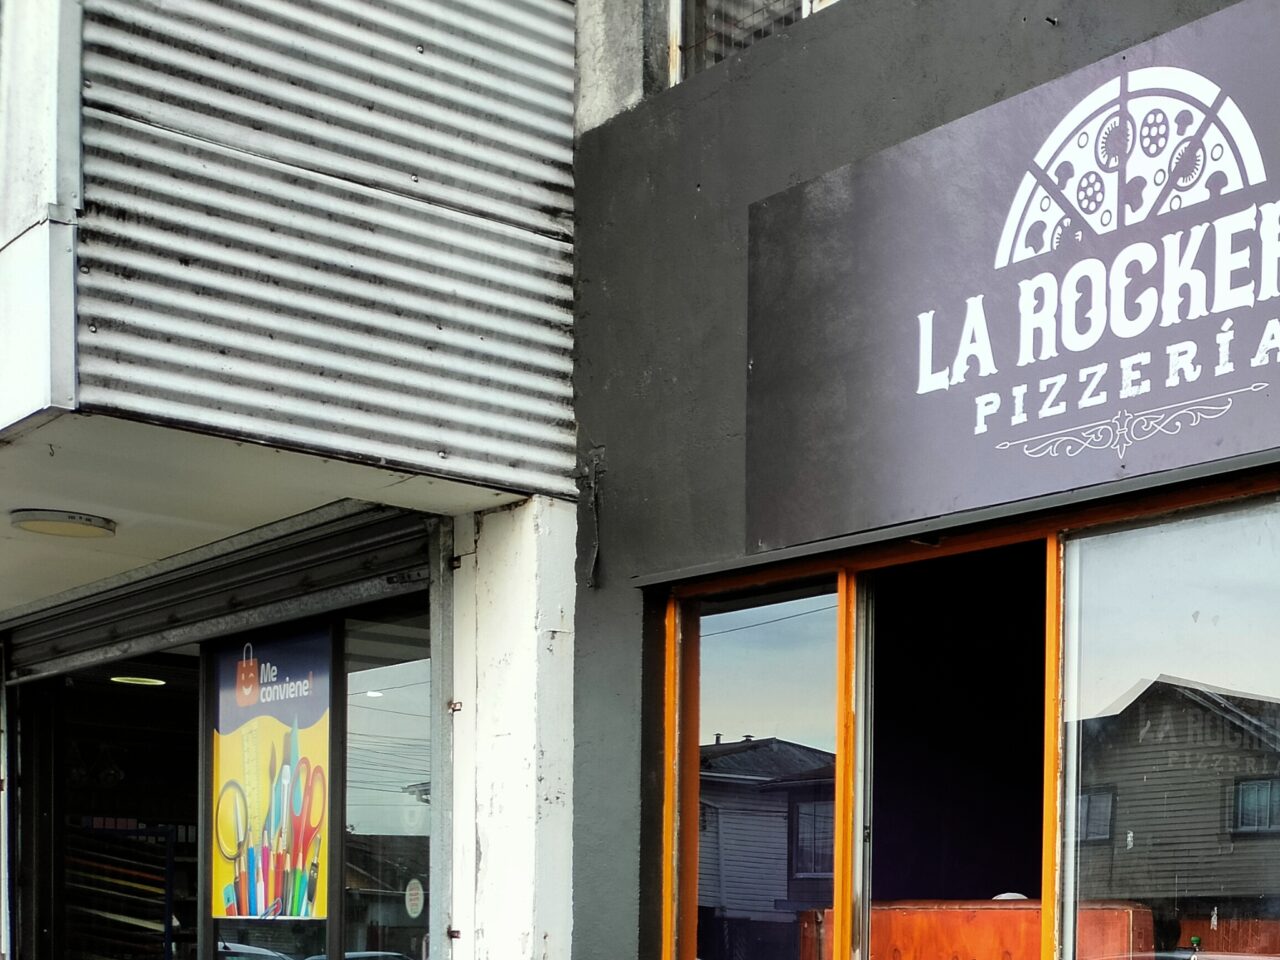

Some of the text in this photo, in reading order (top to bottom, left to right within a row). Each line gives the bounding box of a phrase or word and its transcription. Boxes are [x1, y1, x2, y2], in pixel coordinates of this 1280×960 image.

[916, 295, 998, 394] LA
[260, 662, 278, 683] Me
[260, 671, 313, 702] conviene!
